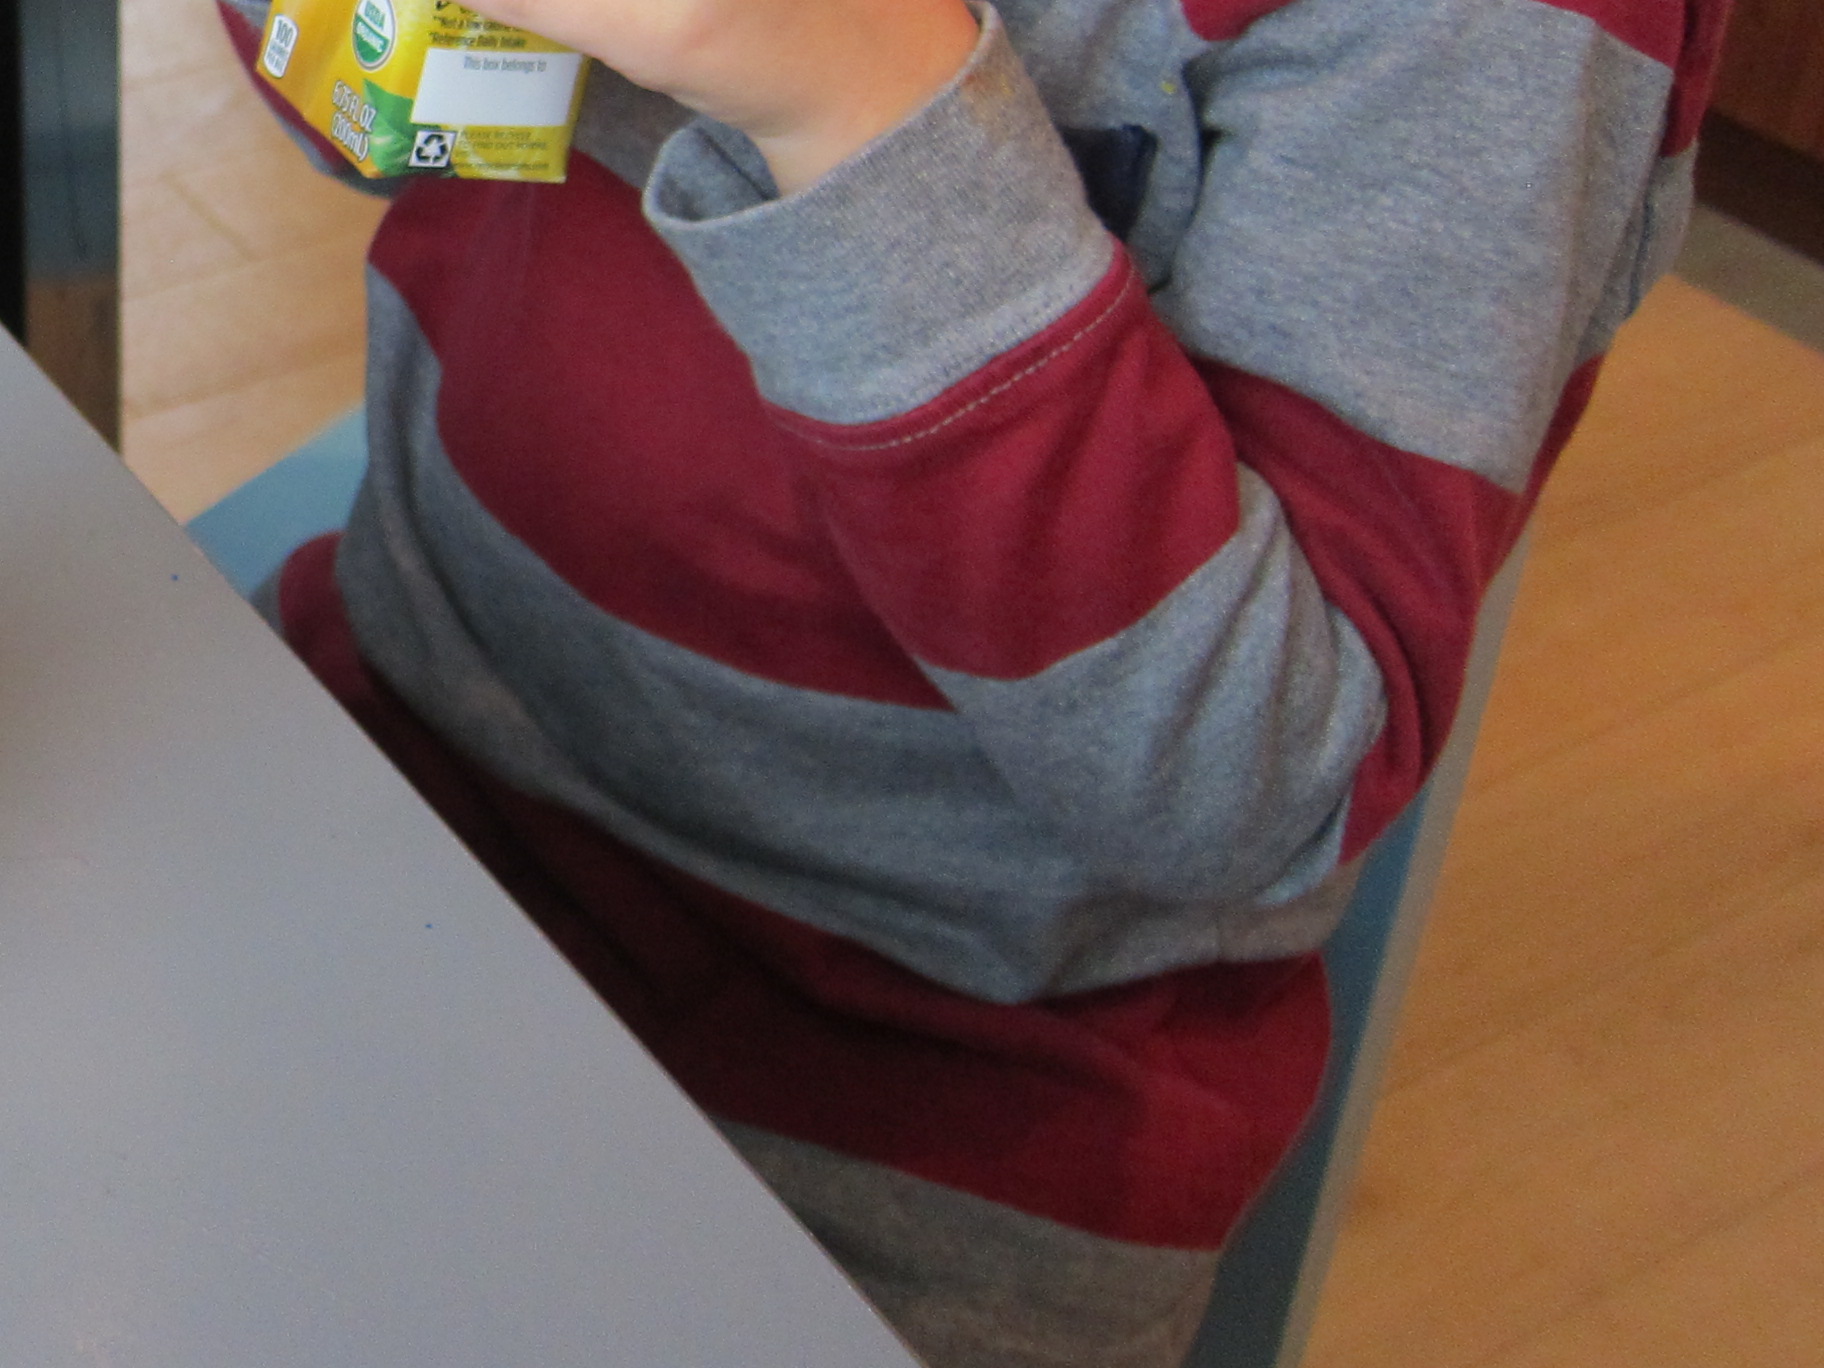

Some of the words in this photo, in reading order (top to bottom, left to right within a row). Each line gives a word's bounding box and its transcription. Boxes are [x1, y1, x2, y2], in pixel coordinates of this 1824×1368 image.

[276, 18, 295, 48] 100
[483, 57, 498, 70] box
[501, 58, 536, 72] belongs
[360, 103, 377, 133] OZ
